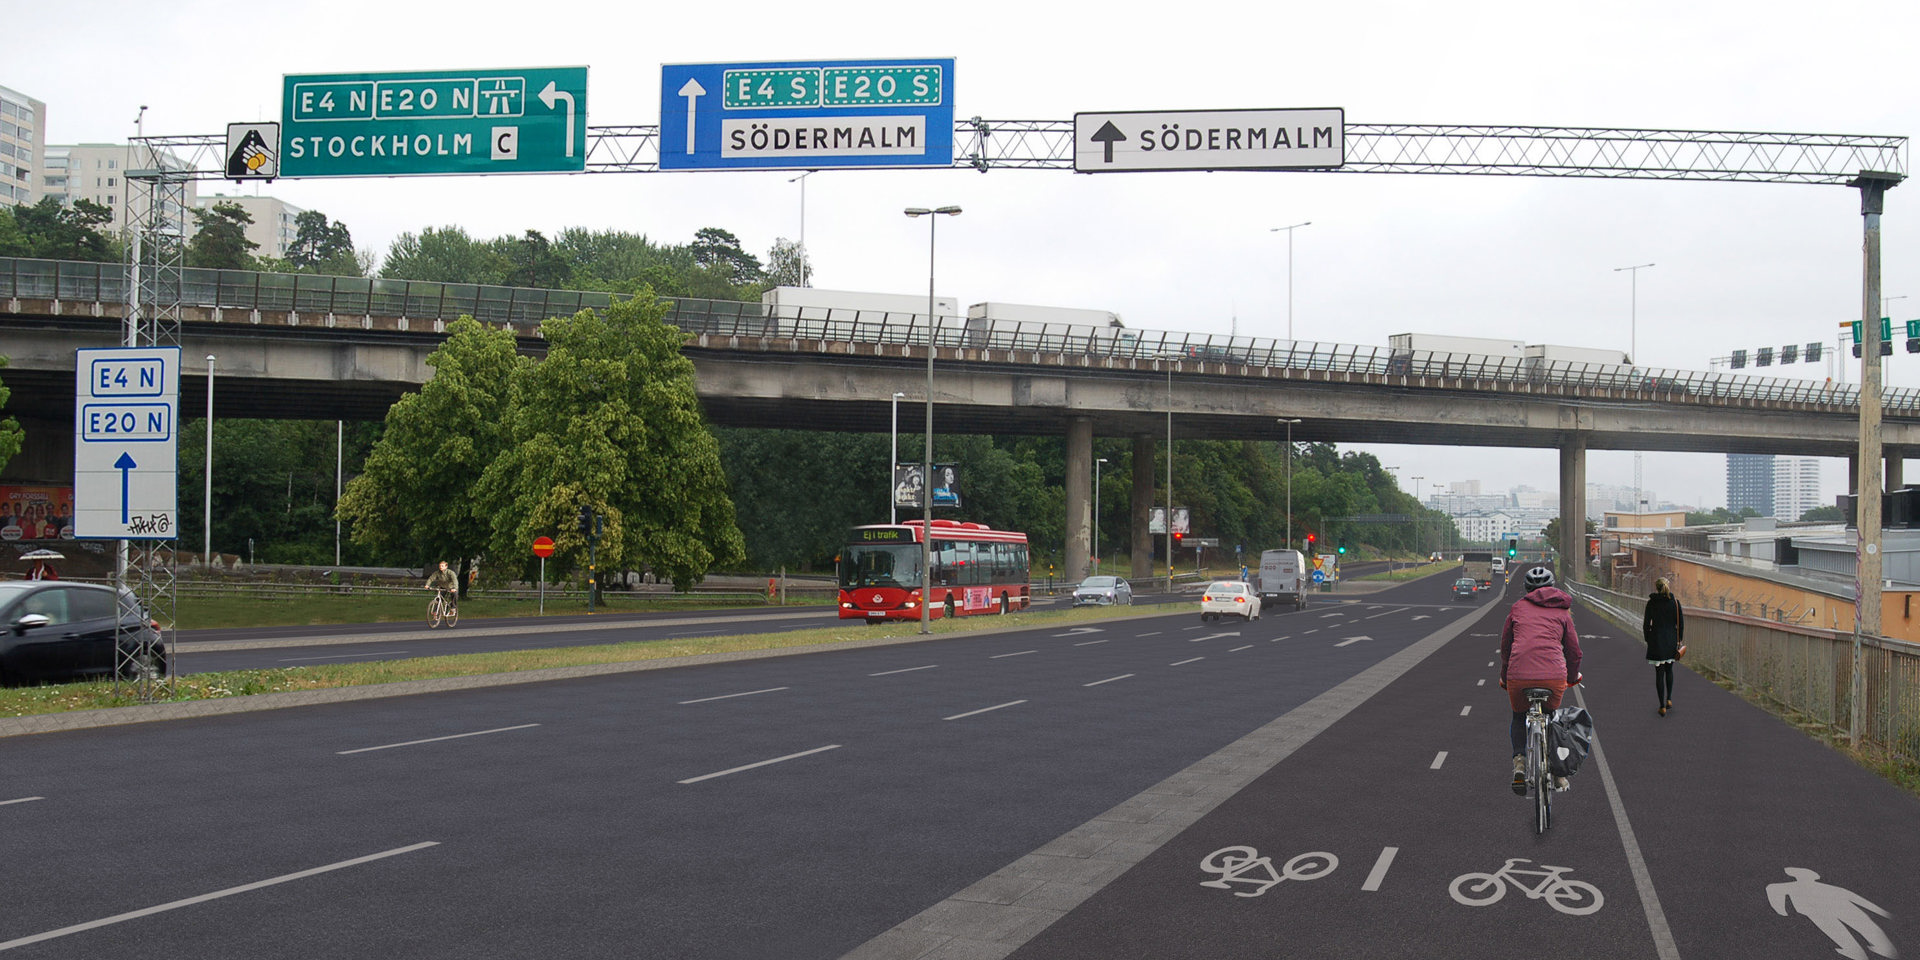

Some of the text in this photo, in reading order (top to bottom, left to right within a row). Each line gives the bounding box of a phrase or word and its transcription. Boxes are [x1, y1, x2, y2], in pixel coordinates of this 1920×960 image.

[739, 77, 806, 100] E4 S
[835, 74, 929, 98] E20 S
[302, 90, 366, 113] E4 N
[381, 87, 469, 111] E20 N
[290, 132, 512, 158] STOCKHOLM C
[730, 123, 915, 151] SÖDERMALM
[1140, 123, 1332, 152] SÖDERMALM
[100, 367, 155, 389] E4 N
[90, 411, 163, 434] E20 N
[863, 530, 872, 541] Ej
